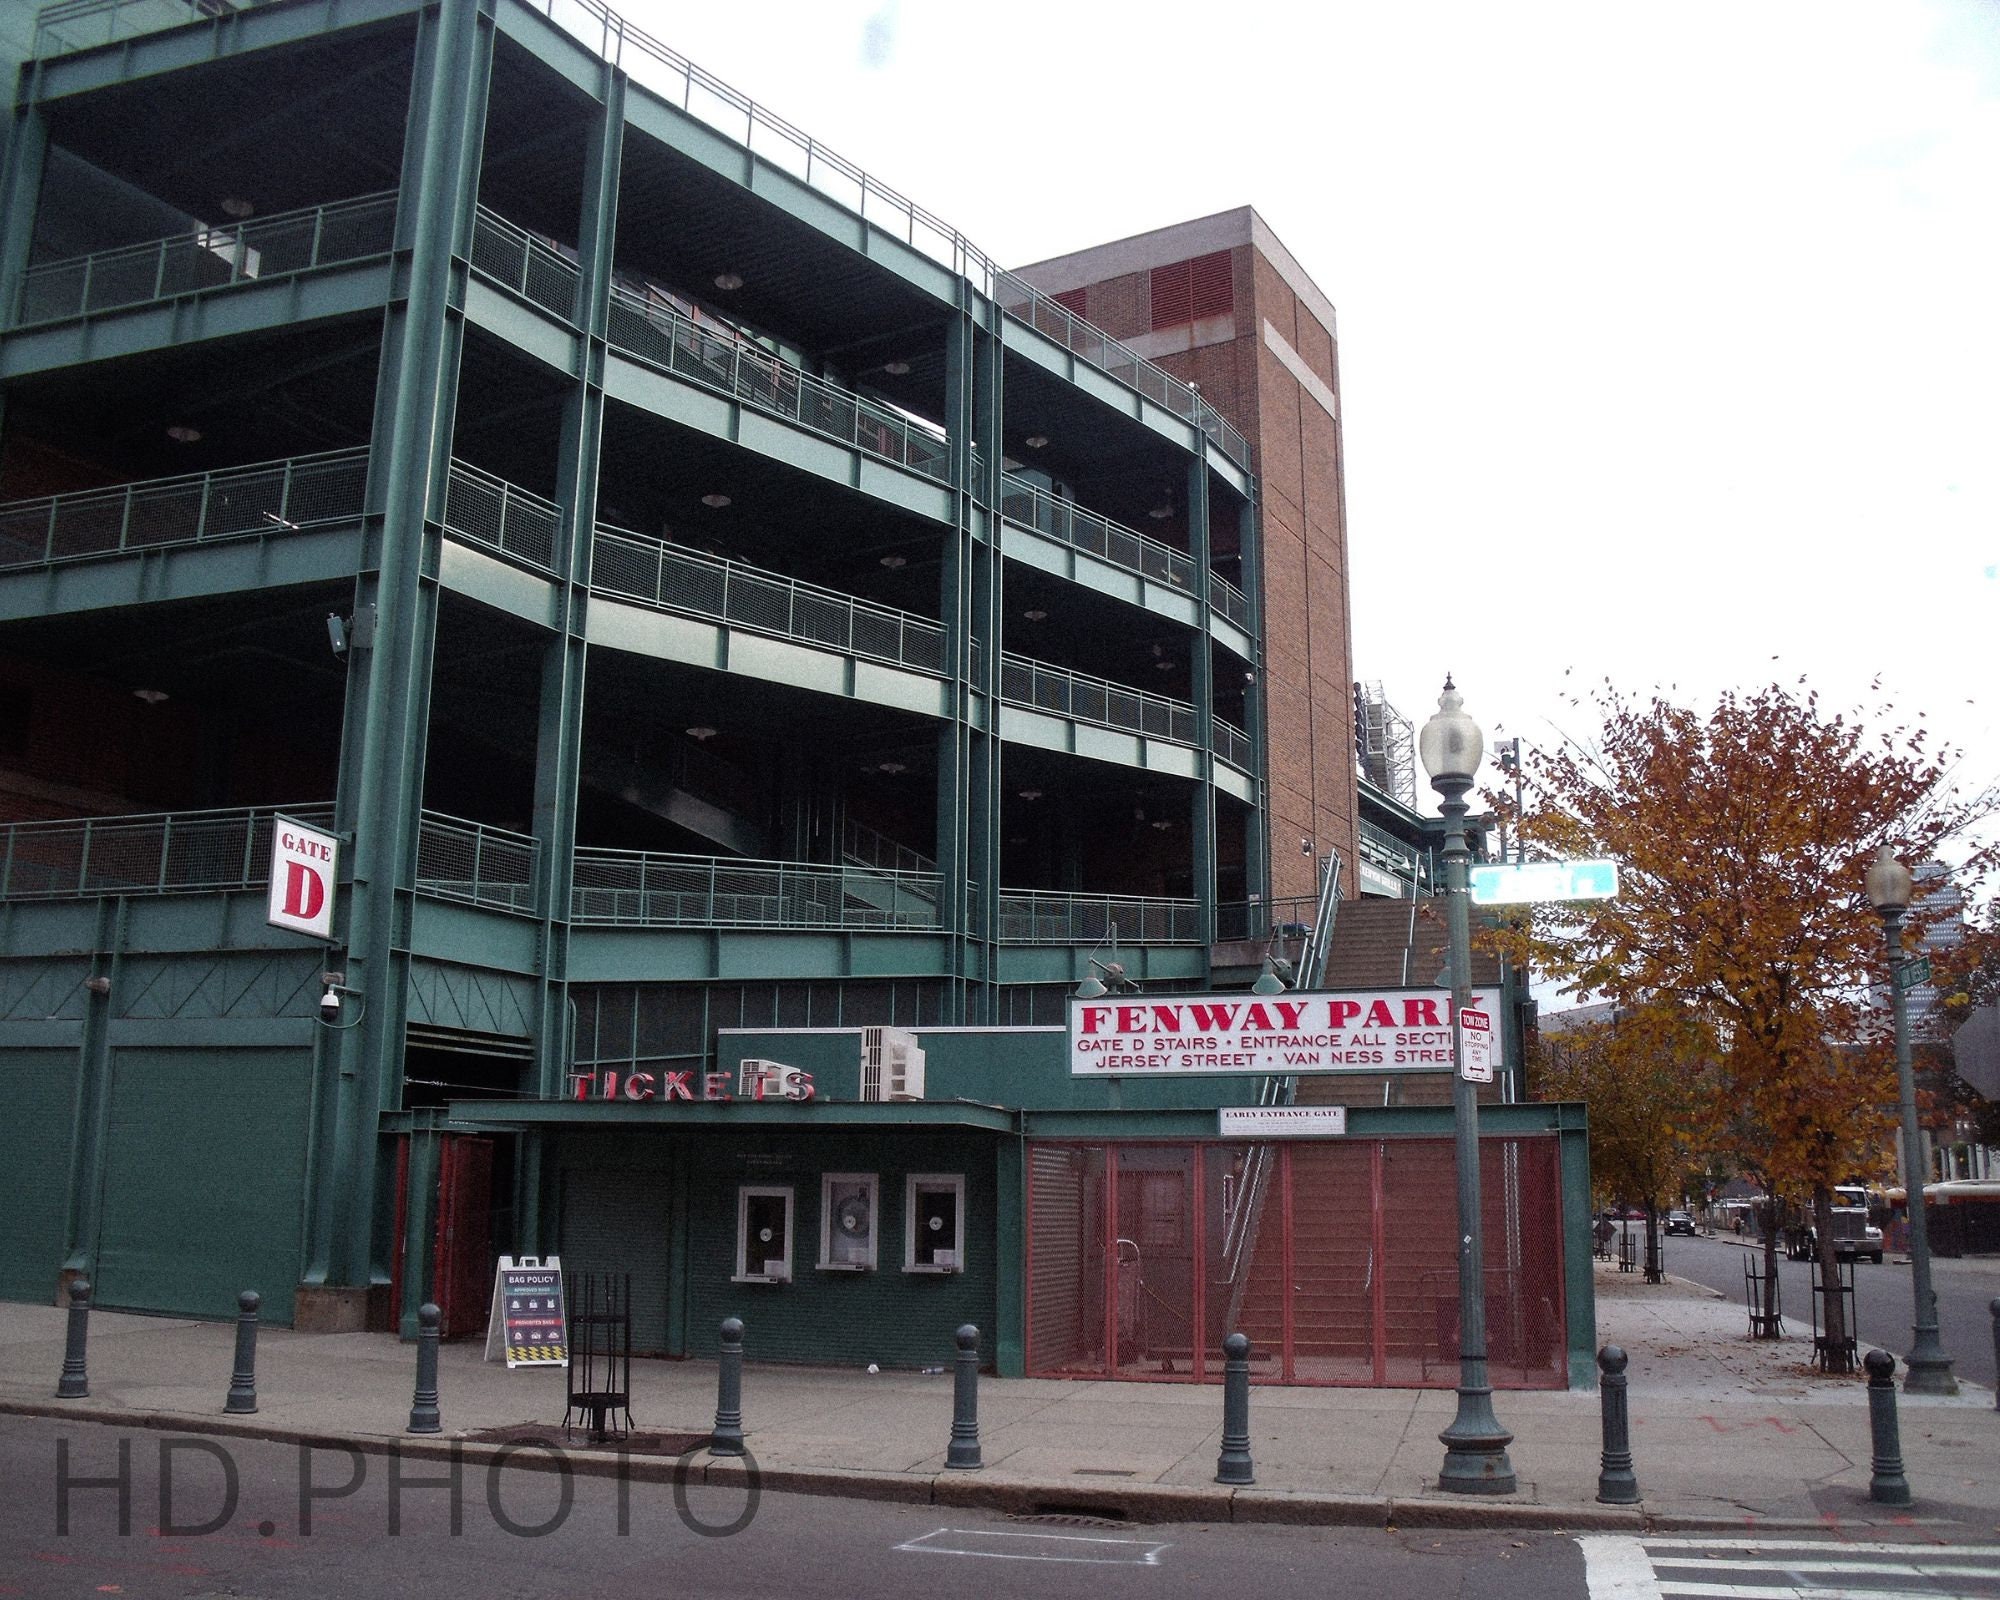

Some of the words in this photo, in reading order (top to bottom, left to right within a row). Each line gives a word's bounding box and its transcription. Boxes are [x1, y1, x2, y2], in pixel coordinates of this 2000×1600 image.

[282, 833, 331, 862] GATE
[282, 860, 324, 919] D
[1080, 1002, 1308, 1034] FENWAY
[1462, 1014, 1475, 1026] TOW
[1475, 1016, 1488, 1029] ZONE
[1077, 1039, 1123, 1051] GATE
[1133, 1039, 1144, 1050] D
[1154, 1037, 1217, 1050] STAIRS
[1241, 1034, 1341, 1048] ENTRANCE
[1350, 1034, 1386, 1046] ALL
[1470, 1032, 1482, 1041] NO
[1464, 1041, 1488, 1050] STOPPING
[1096, 1055, 1171, 1068] JERSEY
[1181, 1053, 1256, 1066] STREET
[1284, 1052, 1319, 1064] VAN
[1331, 1051, 1383, 1063] NESS
[567, 1071, 814, 1100] TICKETS
